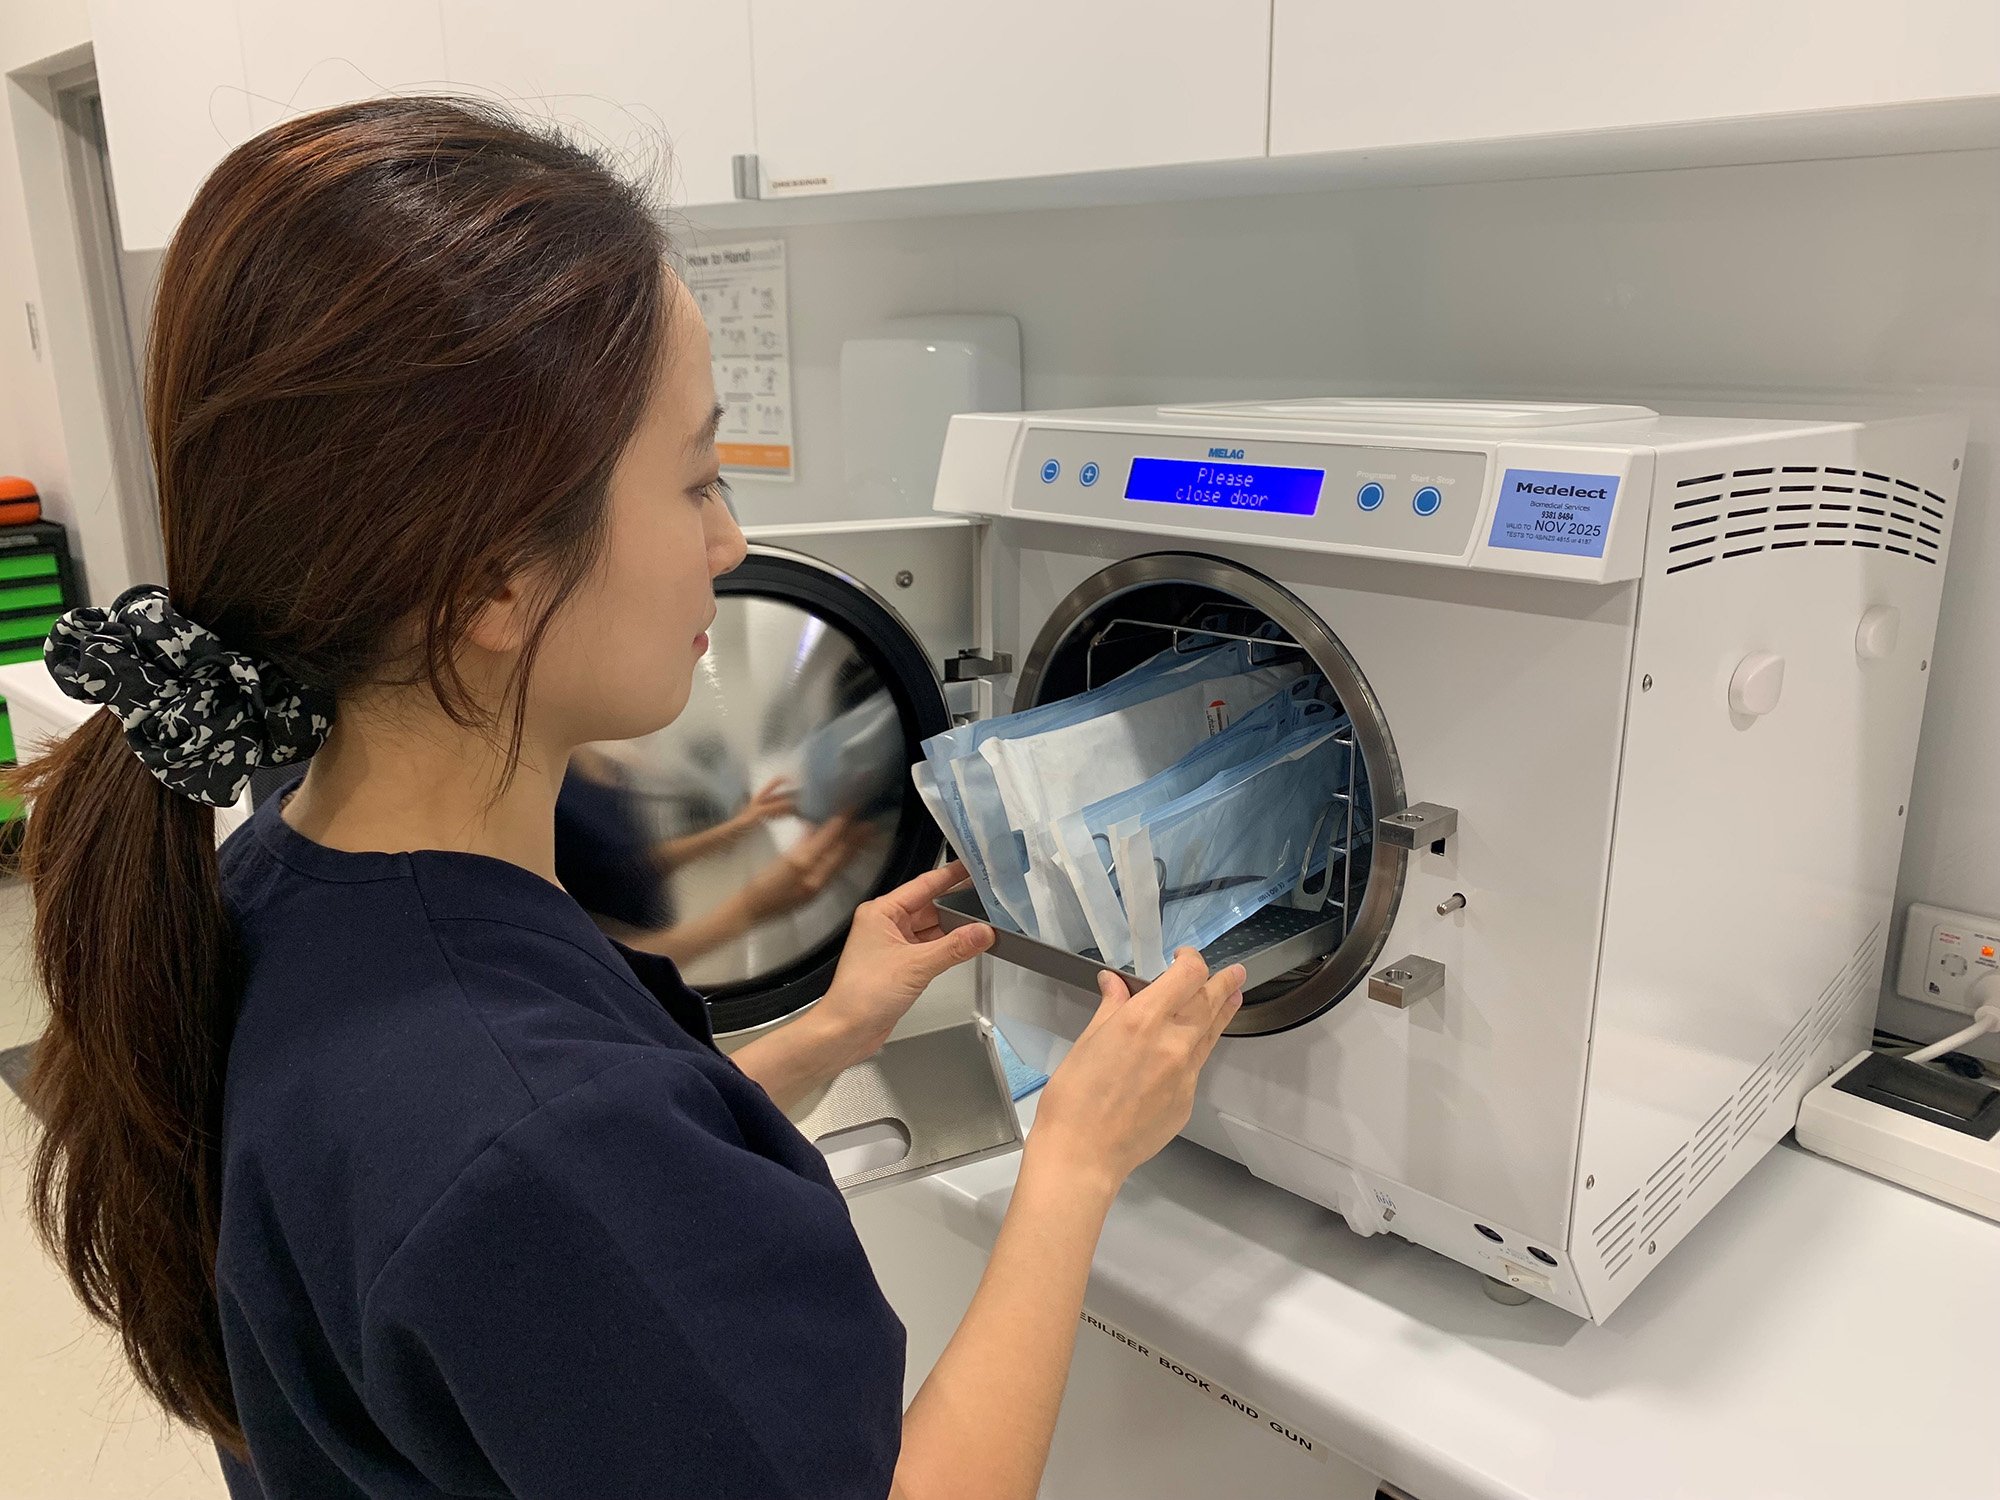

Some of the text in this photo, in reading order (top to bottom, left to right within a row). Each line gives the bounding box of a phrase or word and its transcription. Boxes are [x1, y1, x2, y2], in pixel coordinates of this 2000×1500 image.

[1208, 447, 1244, 460] MELAG
[1197, 466, 1254, 488] Please
[1175, 485, 1269, 508] close door
[1516, 481, 1608, 500] Medelect
[1564, 502, 1591, 512] Services
[1534, 519, 1567, 533] NOV
[1568, 523, 1602, 537] 2025
[1159, 1356, 1211, 1393] BOOK
[1219, 1392, 1259, 1419] AND
[1268, 1420, 1313, 1451] GUN
